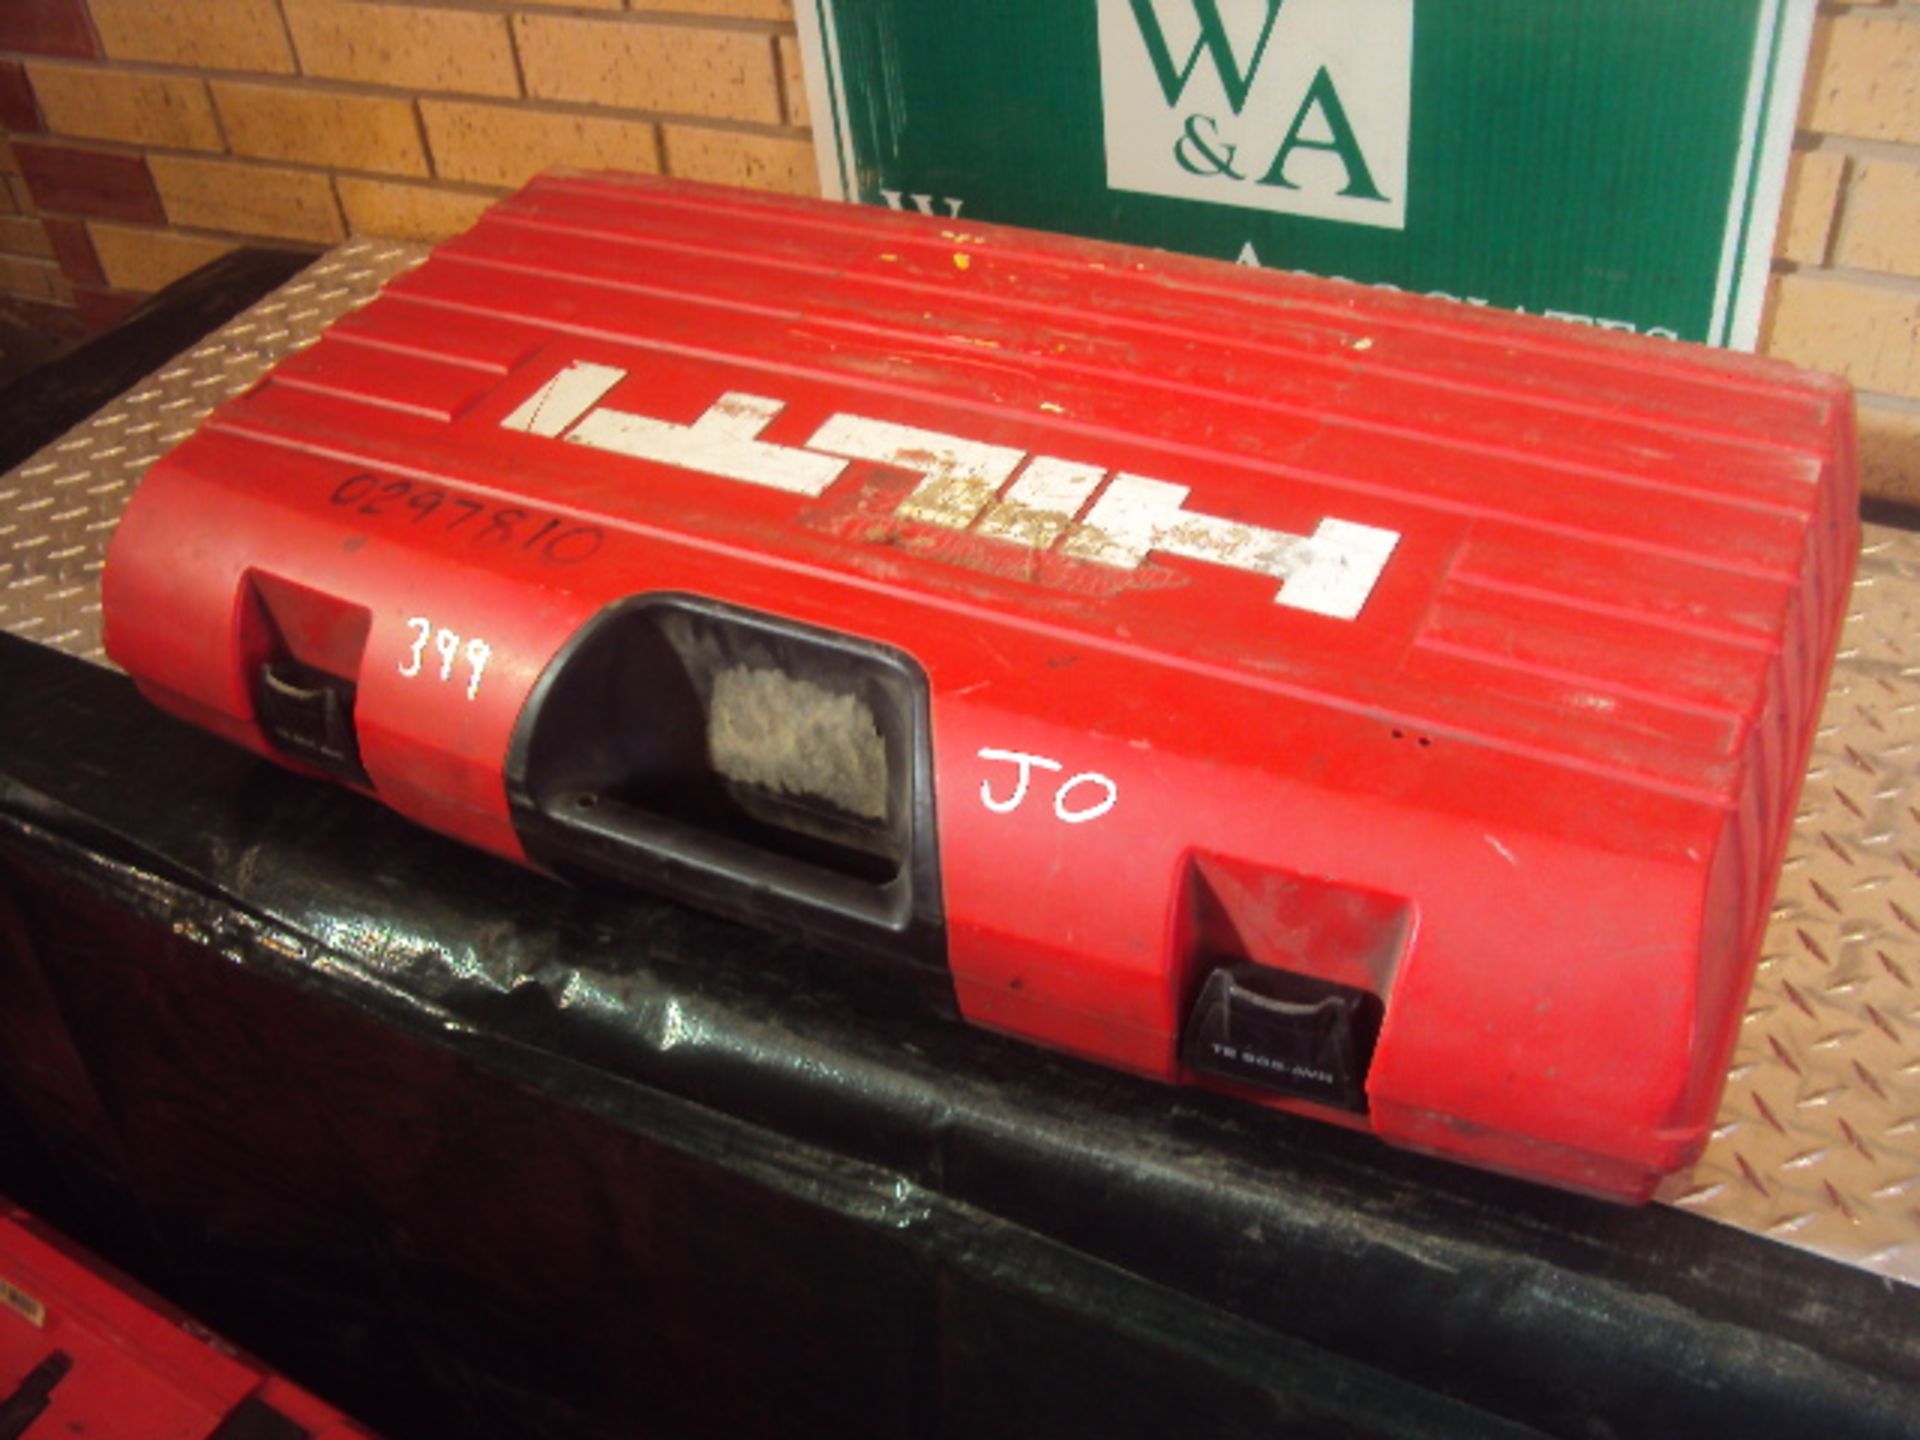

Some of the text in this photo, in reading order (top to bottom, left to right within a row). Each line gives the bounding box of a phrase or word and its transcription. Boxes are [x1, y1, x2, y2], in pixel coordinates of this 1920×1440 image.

[330, 473, 604, 566] 0297810
[500, 358, 1401, 621] HILTI
[398, 616, 493, 700] 399
[977, 747, 1118, 823] JO
